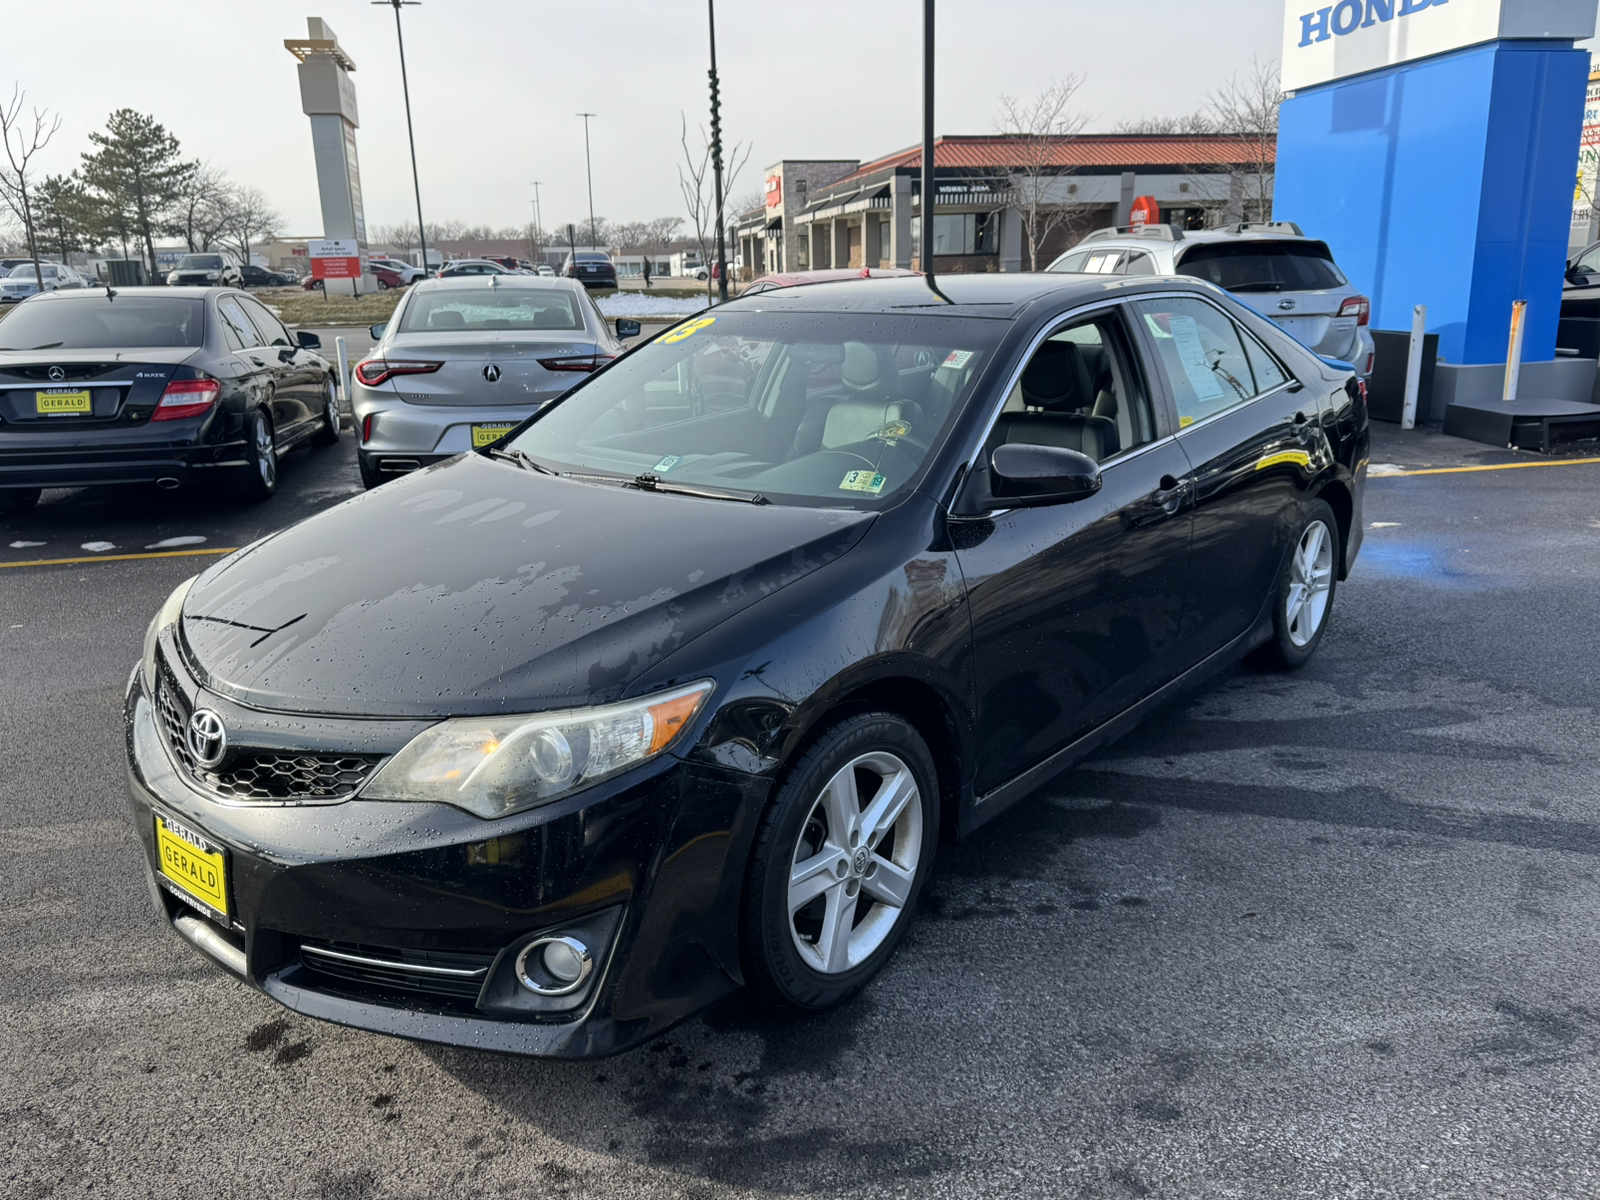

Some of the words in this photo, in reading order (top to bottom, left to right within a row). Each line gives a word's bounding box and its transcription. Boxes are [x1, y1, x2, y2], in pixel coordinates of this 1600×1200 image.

[1297, 0, 1450, 48] HON
[43, 399, 84, 407] GERALD
[479, 433, 505, 441] GERA
[849, 471, 859, 483] 3
[871, 475, 883, 486] 19
[165, 818, 207, 851] GERALD
[165, 845, 216, 888] GERALD
[169, 885, 211, 918] COUNTRYSIDE
